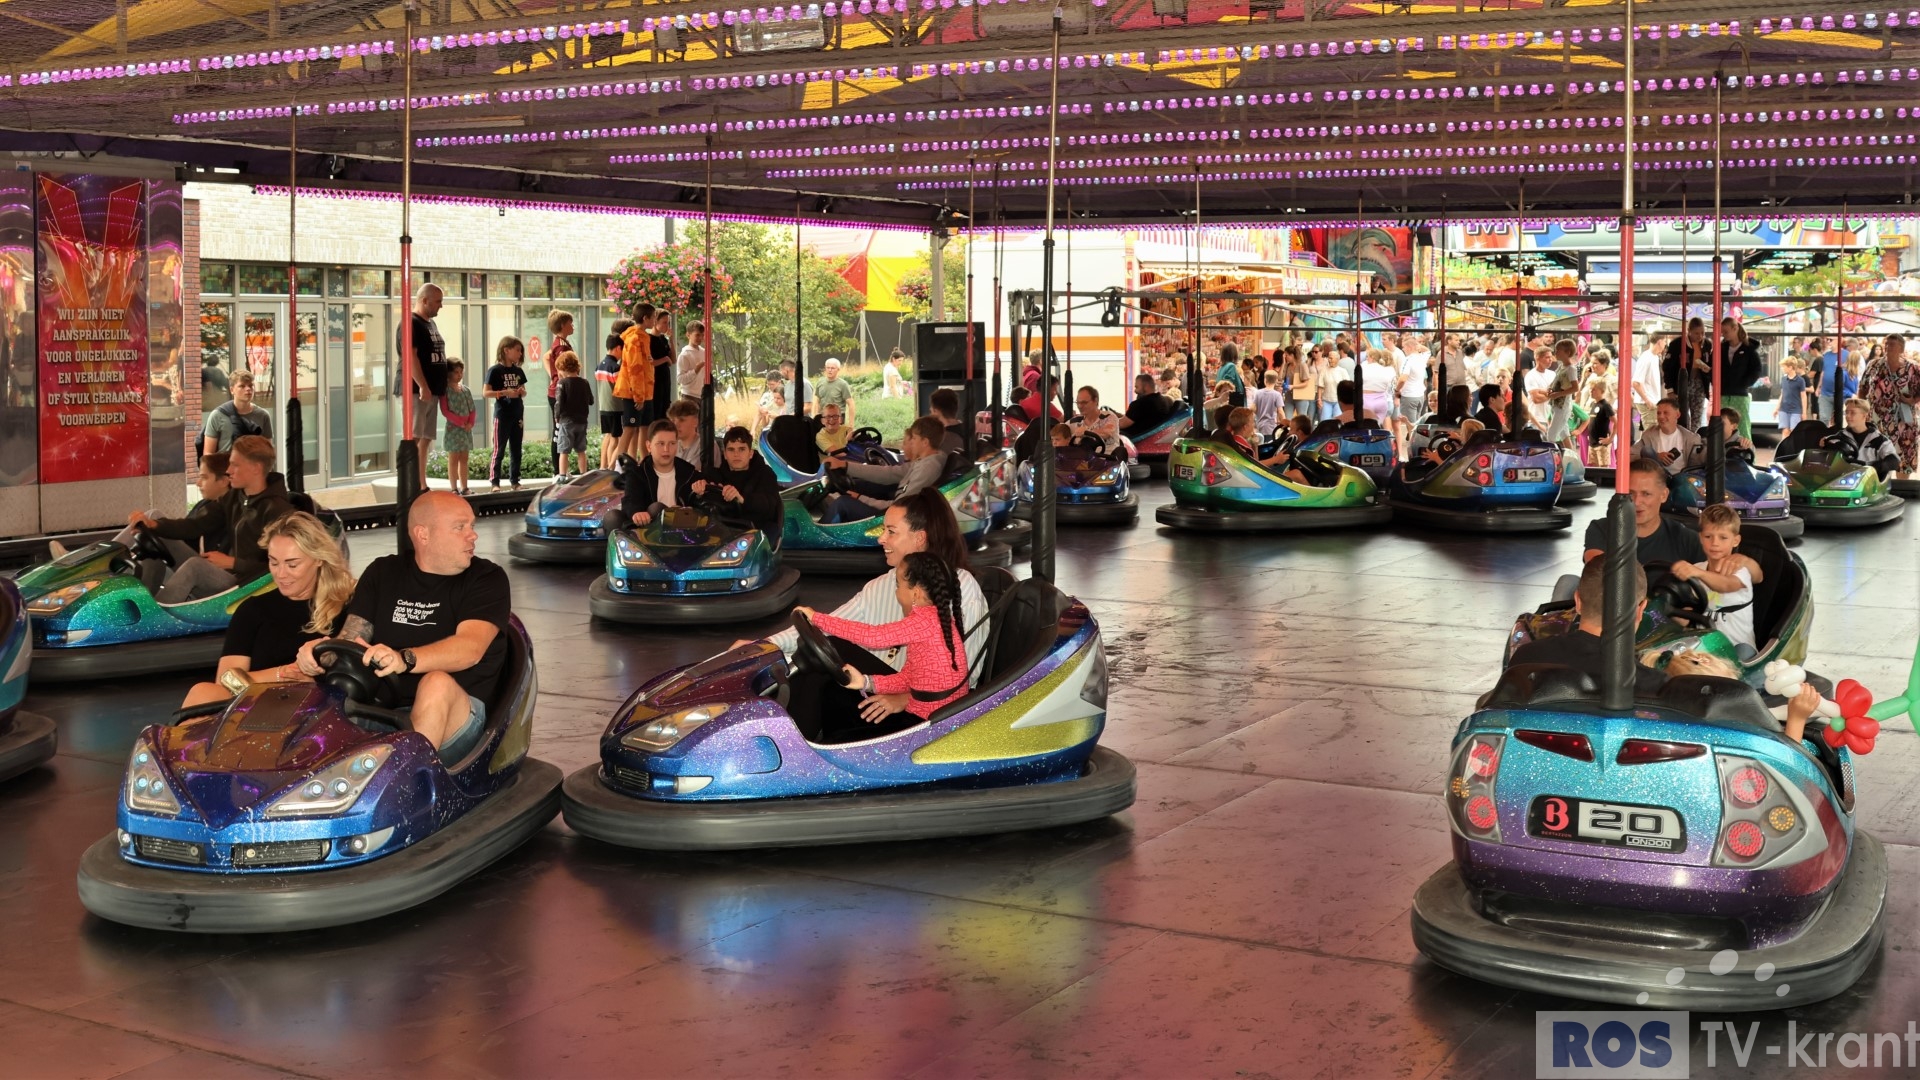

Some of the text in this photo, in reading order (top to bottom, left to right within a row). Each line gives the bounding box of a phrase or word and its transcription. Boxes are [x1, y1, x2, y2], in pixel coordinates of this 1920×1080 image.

[57, 308, 125, 320] WIJ ZIJN NIET
[53, 329, 130, 341] AANSPRAKELIJK
[45, 350, 138, 363] VOOR ONGELUKKEN
[58, 371, 125, 384] EN VERLOREN
[48, 391, 142, 405] OF STUK GERAAKTE
[59, 412, 126, 426] VOORWERPEN
[1181, 467, 1193, 476] 25
[1589, 808, 1664, 835] 20
[1626, 836, 1672, 849] LONDON
